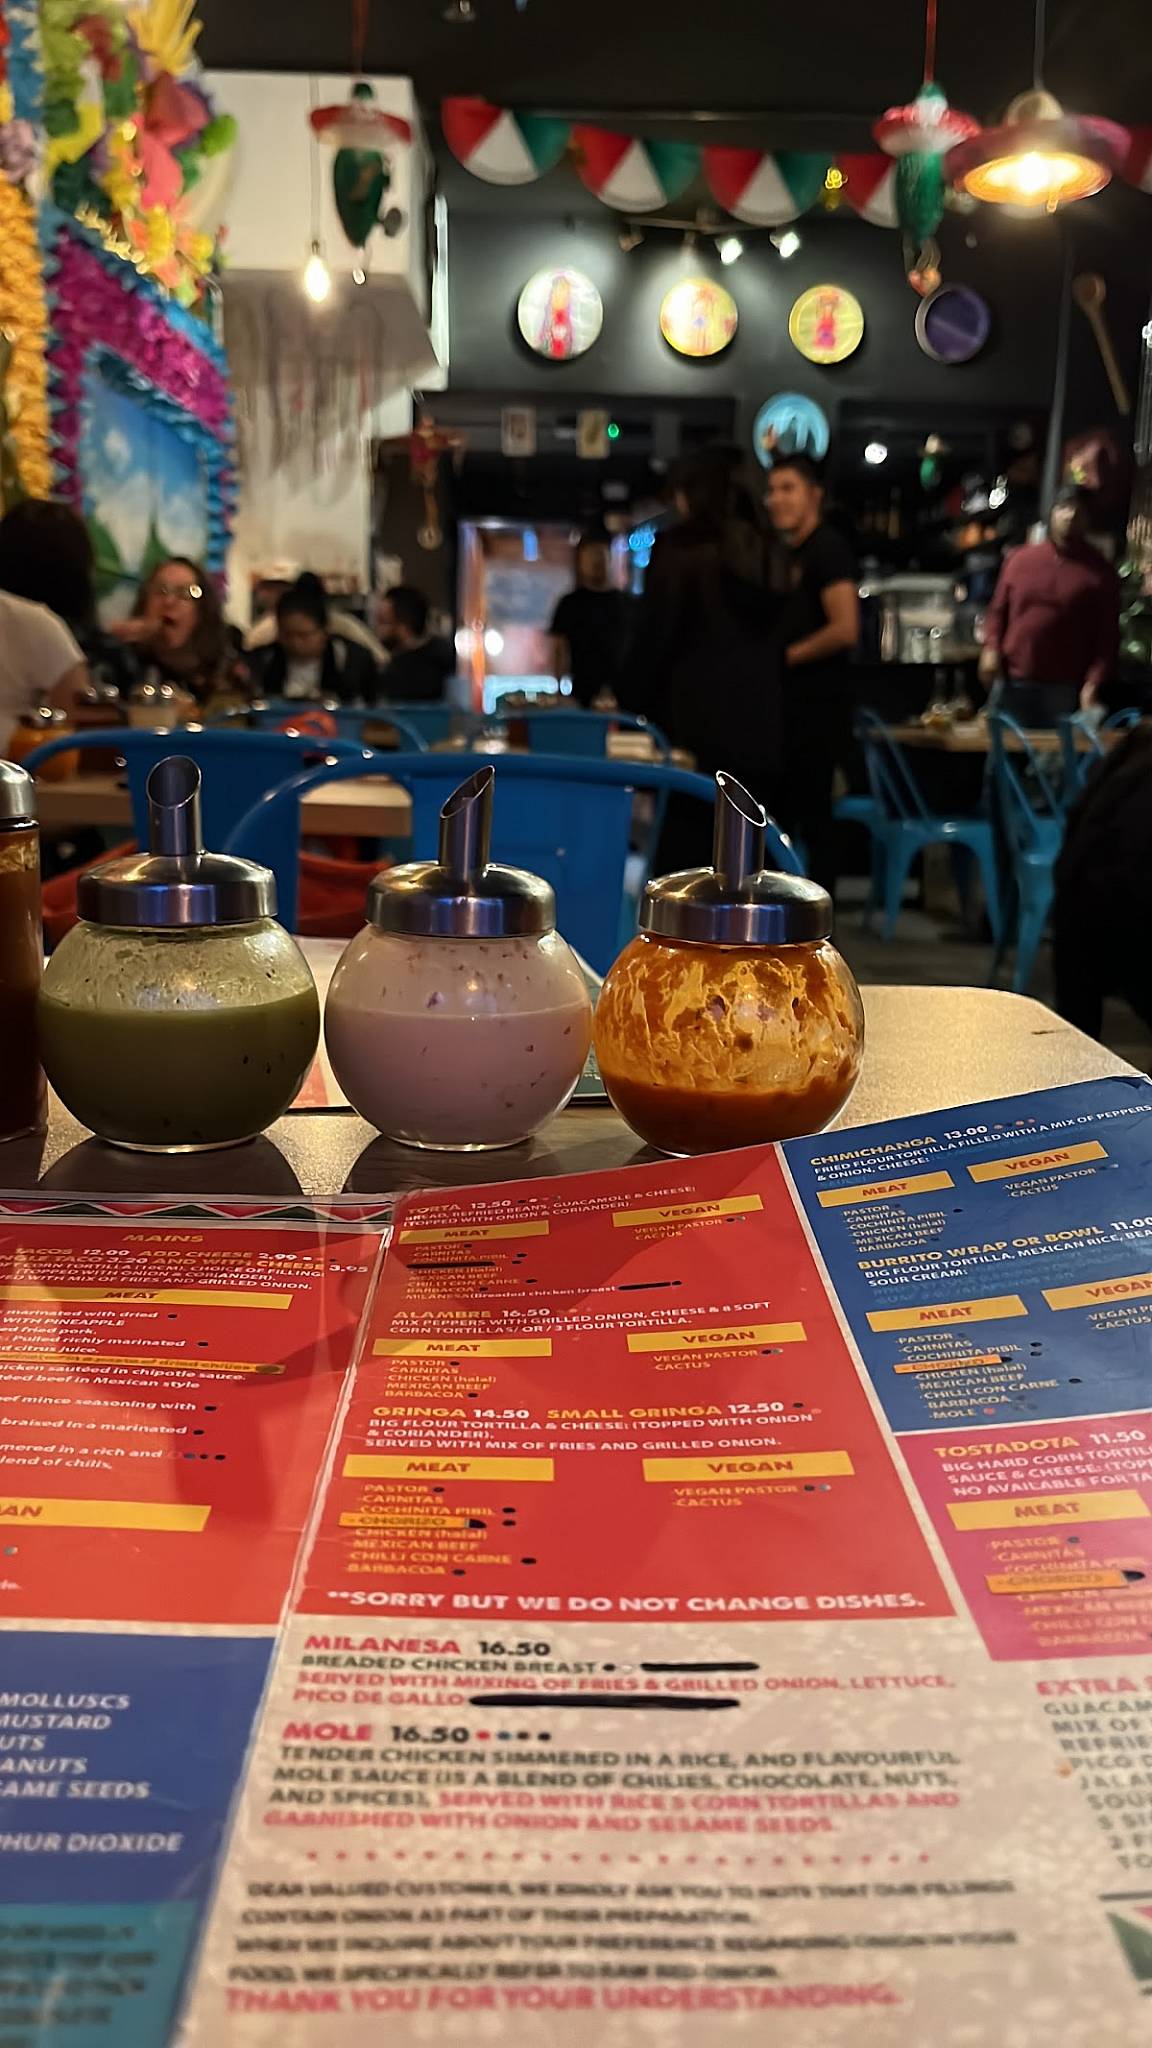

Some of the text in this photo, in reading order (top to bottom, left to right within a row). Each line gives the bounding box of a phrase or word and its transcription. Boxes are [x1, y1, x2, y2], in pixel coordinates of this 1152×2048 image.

[811, 1126, 988, 1166] CHIMICHANGA 13.00
[814, 1164, 850, 1174] FRIED
[853, 1155, 895, 1168] FLOUR
[896, 1143, 956, 1159] TORTILLA
[958, 1134, 1001, 1147] FILLED
[1003, 1128, 1036, 1138] WITH
[1051, 1119, 1075, 1129] MIX
[1077, 1115, 1093, 1123] OF
[1096, 1104, 1152, 1120] PEPPERS
[1005, 1153, 1070, 1170] VEGAN
[862, 1183, 908, 1196] MEAT
[408, 1200, 511, 1213] TORTA 13.50
[660, 1204, 721, 1217] VEGAN
[122, 1234, 204, 1243] MAINS
[857, 1226, 1105, 1270] BURRITO WRAP OR BOWL
[203, 1258, 250, 1266] WITH
[257, 1261, 324, 1270] CHEESE
[865, 1268, 894, 1279] BIG
[895, 1262, 941, 1275] FLOUR
[1018, 1241, 1084, 1257] MEXICAN
[1087, 1235, 1123, 1246] RICE,
[260, 1281, 312, 1290] ONION.
[868, 1277, 912, 1287] SOUR
[394, 1309, 550, 1319] ALAMBRE 16.50
[531, 1314, 592, 1324] GRILLED
[651, 1307, 706, 1317] CHEESE
[734, 1301, 771, 1310] SOFT
[920, 1307, 973, 1320] MEAT
[566, 1321, 617, 1331] FLOUR
[108, 1339, 185, 1347] marinated
[683, 1331, 755, 1344] VEGAN
[426, 1344, 481, 1352] MEAT
[132, 1368, 195, 1378] chipotle
[93, 1377, 200, 1388] Mexican style
[76, 1399, 196, 1410] seasoning with
[373, 1402, 784, 1419] GRINGA 14.50 SMALL GRINGA 12.50
[101, 1423, 187, 1434] marinated
[369, 1419, 398, 1427] BIG
[403, 1420, 458, 1428] FLOUR
[463, 1420, 542, 1429] TORTILLA
[633, 1419, 705, 1430] (TOPPED
[708, 1417, 752, 1427] WITH
[756, 1414, 812, 1425] ONION
[365, 1438, 781, 1450] SERVED WITH MIX OF FRIES AND GRILLED ONION.
[934, 1431, 1145, 1457] TOSTADOTA 11.50
[406, 1462, 470, 1472] MEAT
[707, 1461, 793, 1473] VEGAN
[942, 1453, 1082, 1472] BIG HARD CORN
[948, 1470, 1024, 1483] SAUCE &
[954, 1475, 1127, 1496] NO AVAILABLE FOR
[1015, 1503, 1080, 1517] MEAT
[453, 1595, 509, 1608] BUT
[518, 1596, 561, 1610] WE
[568, 1597, 612, 1610] DO
[621, 1598, 679, 1611] NOT
[687, 1596, 810, 1611] CHANGE
[816, 1593, 925, 1609] DISHES.
[304, 1636, 550, 1656] MILANESA 16.50
[301, 1654, 596, 1673] BREADED CHICKEN BREAST
[299, 1671, 384, 1686] SERVED
[389, 1673, 448, 1687] WITH
[454, 1676, 536, 1689] MIXING
[542, 1677, 571, 1689] OF
[578, 1677, 638, 1691] FRIES
[644, 1678, 659, 1690] &
[666, 1677, 757, 1691] GRILLED
[293, 1689, 465, 1706] PICO DE GALLO
[282, 1722, 470, 1742] MOLE 16.50
[281, 1747, 374, 1761] TENDER
[381, 1749, 485, 1764] CHICKEN
[492, 1751, 620, 1766] SIMMERED
[627, 1754, 650, 1766] IN
[659, 1754, 678, 1766] A
[744, 1753, 797, 1767] AND
[803, 1752, 960, 1766] FLAVOURFUL
[274, 1767, 343, 1781] MOLE
[351, 1768, 429, 1784] SAUCE
[499, 1771, 576, 1787] BLEND
[583, 1771, 616, 1787] OF
[67, 1781, 150, 1799] SEEDS
[66, 1833, 183, 1852] DIOXIDE
[226, 1987, 594, 2012] THANK YOU FOR YOUR
